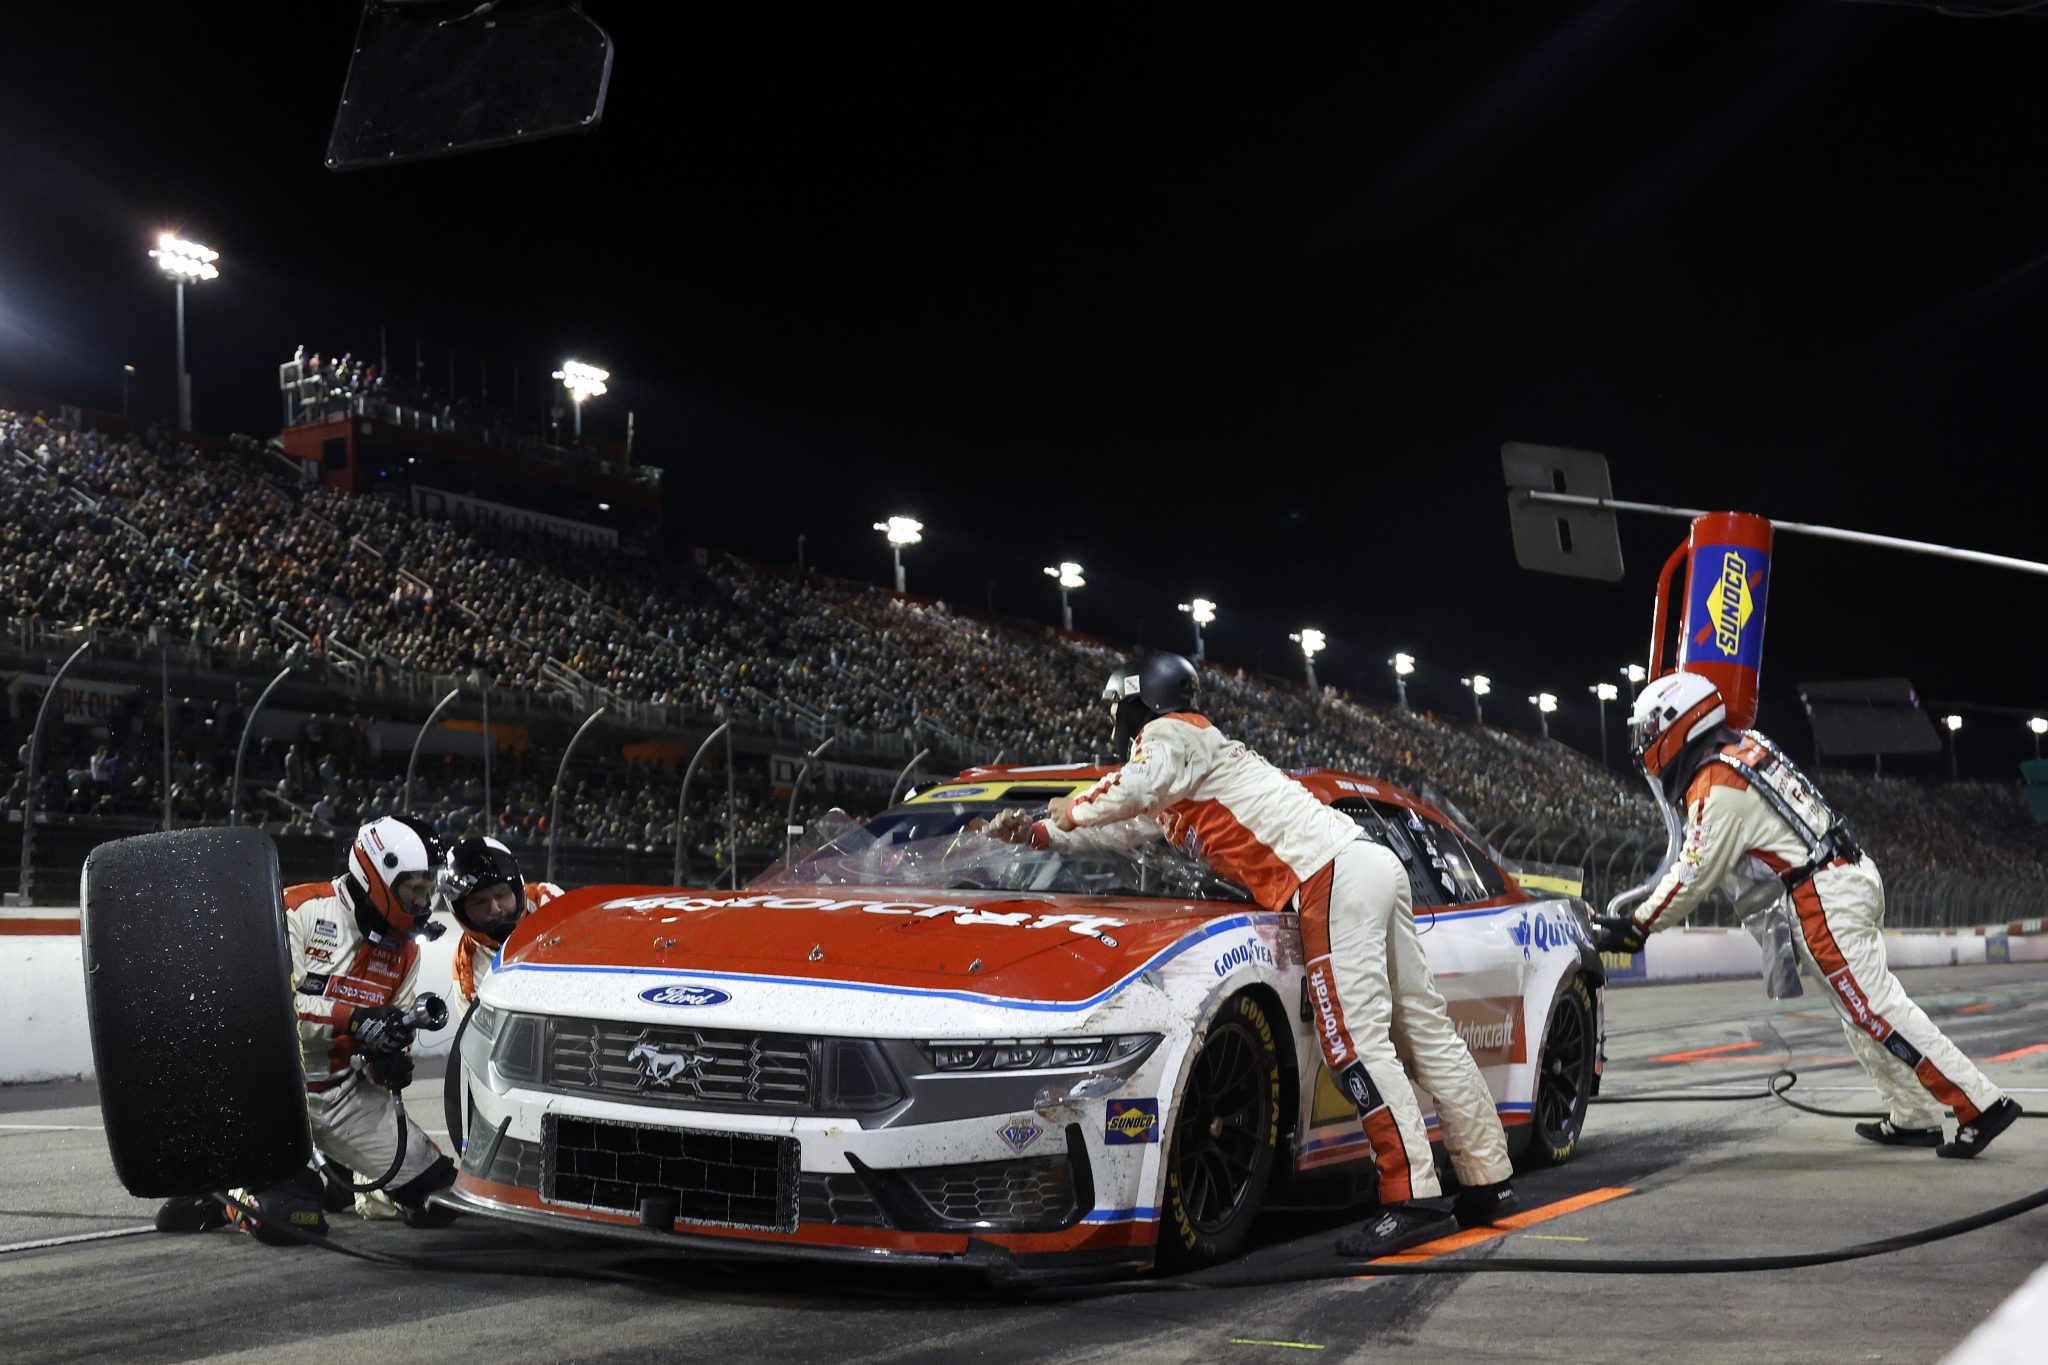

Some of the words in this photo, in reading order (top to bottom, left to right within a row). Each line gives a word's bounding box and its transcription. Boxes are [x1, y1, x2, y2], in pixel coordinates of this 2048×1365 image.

[1720, 557, 1744, 651] SUNOCO
[602, 895, 1126, 939] Motorcraft
[332, 982, 384, 1004] Motorcraft
[653, 986, 714, 1005] Ford
[1310, 967, 1348, 1065] Motorcraft
[1109, 1115, 1154, 1131] SUNOCO
